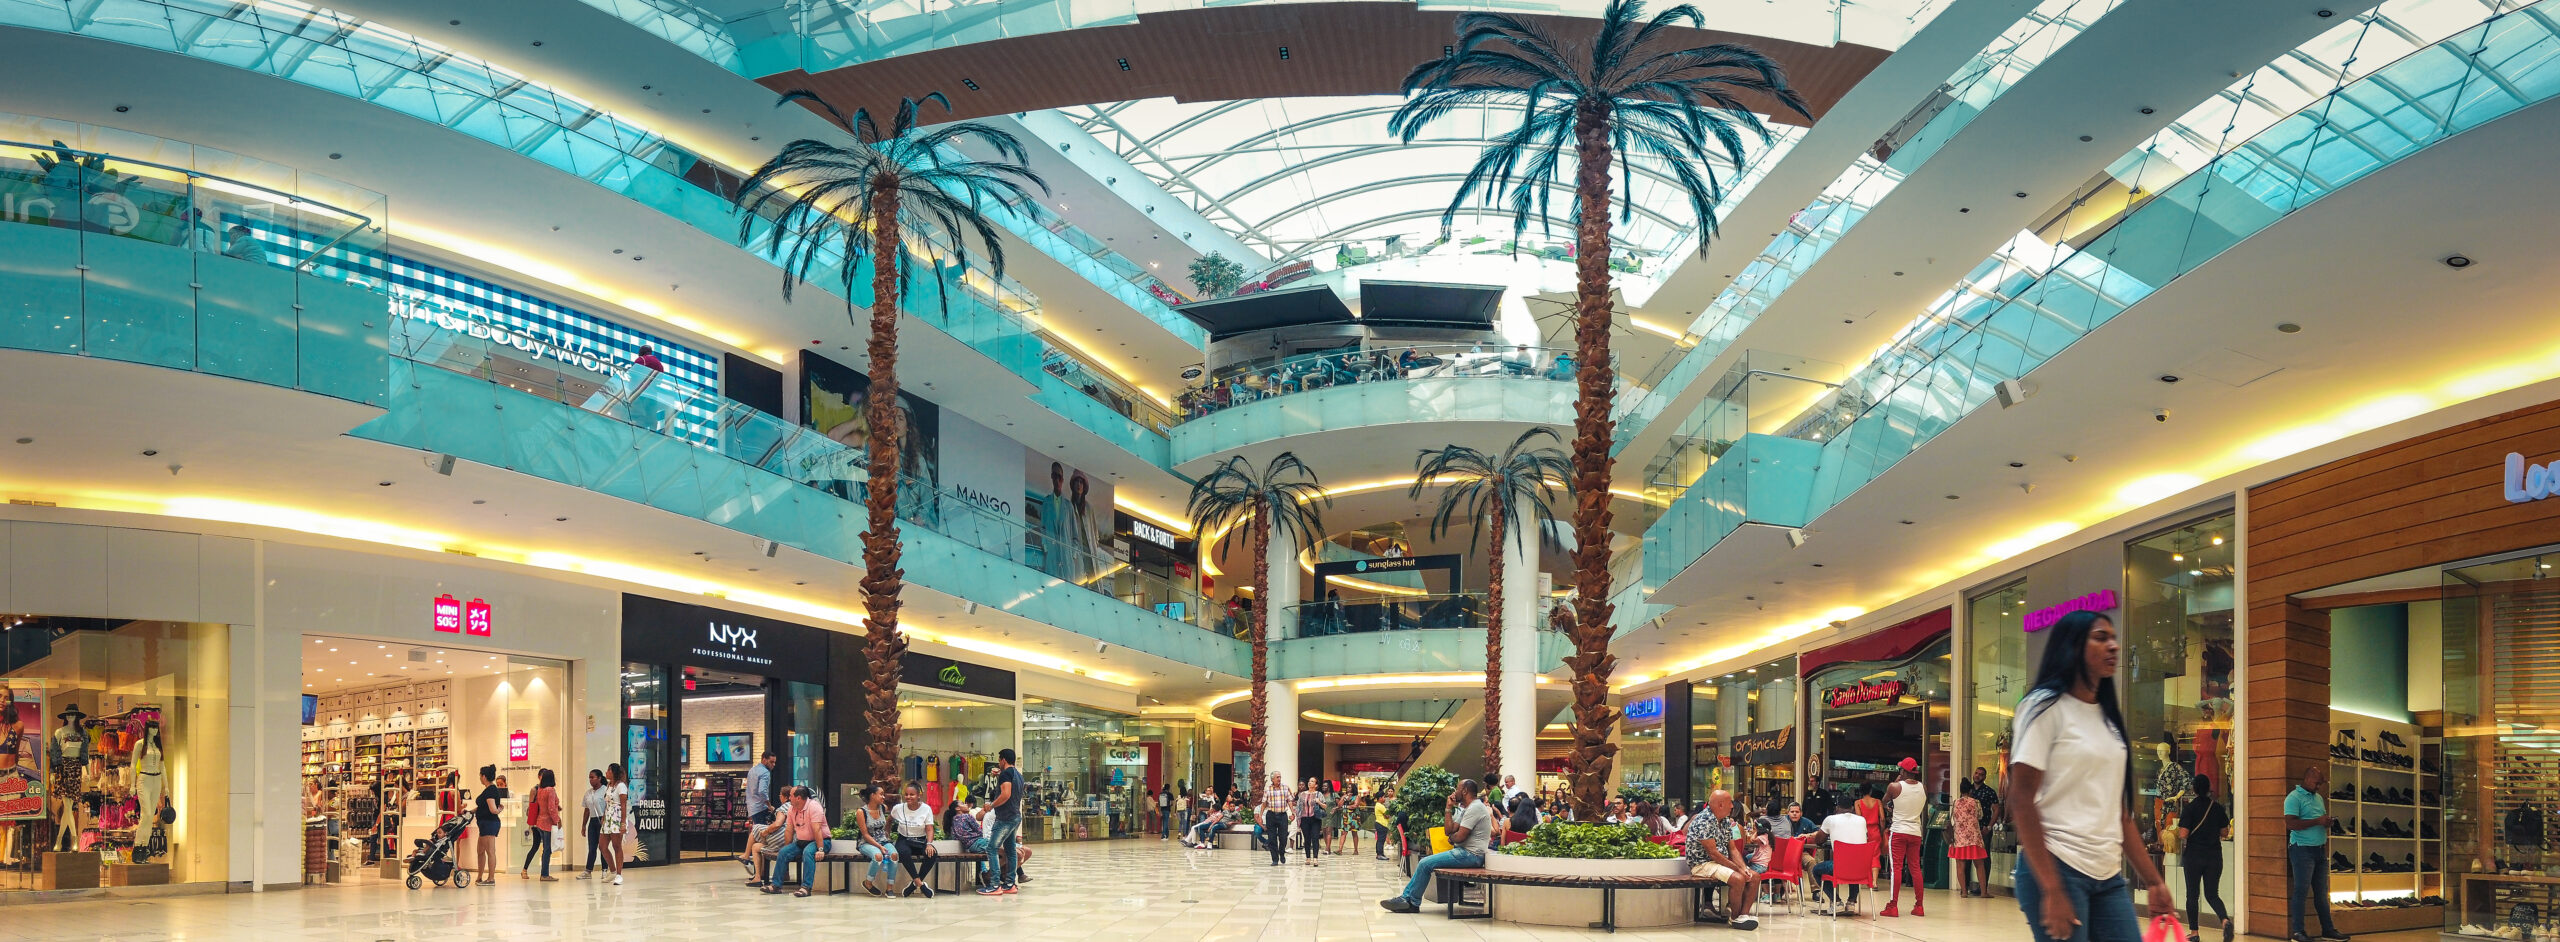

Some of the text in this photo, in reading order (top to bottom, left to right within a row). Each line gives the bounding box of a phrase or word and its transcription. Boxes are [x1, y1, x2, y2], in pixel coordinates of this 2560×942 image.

[468, 307, 549, 360] Body
[956, 483, 1011, 516] MANGO
[1133, 520, 1175, 549] BACK & FORTH
[1368, 560, 1401, 569] sunglass
[437, 604, 458, 616] MINI
[470, 608, 487, 619] メイ
[709, 622, 757, 649] NYX
[692, 647, 773, 665] PROFESSIONAL MAKEUP
[1830, 680, 1900, 709] Santo Domingo
[511, 739, 527, 747] MINI
[28, 786, 41, 794] de
[639, 799, 665, 809] PRUEBA
[639, 816, 664, 830] AQUÍ!
